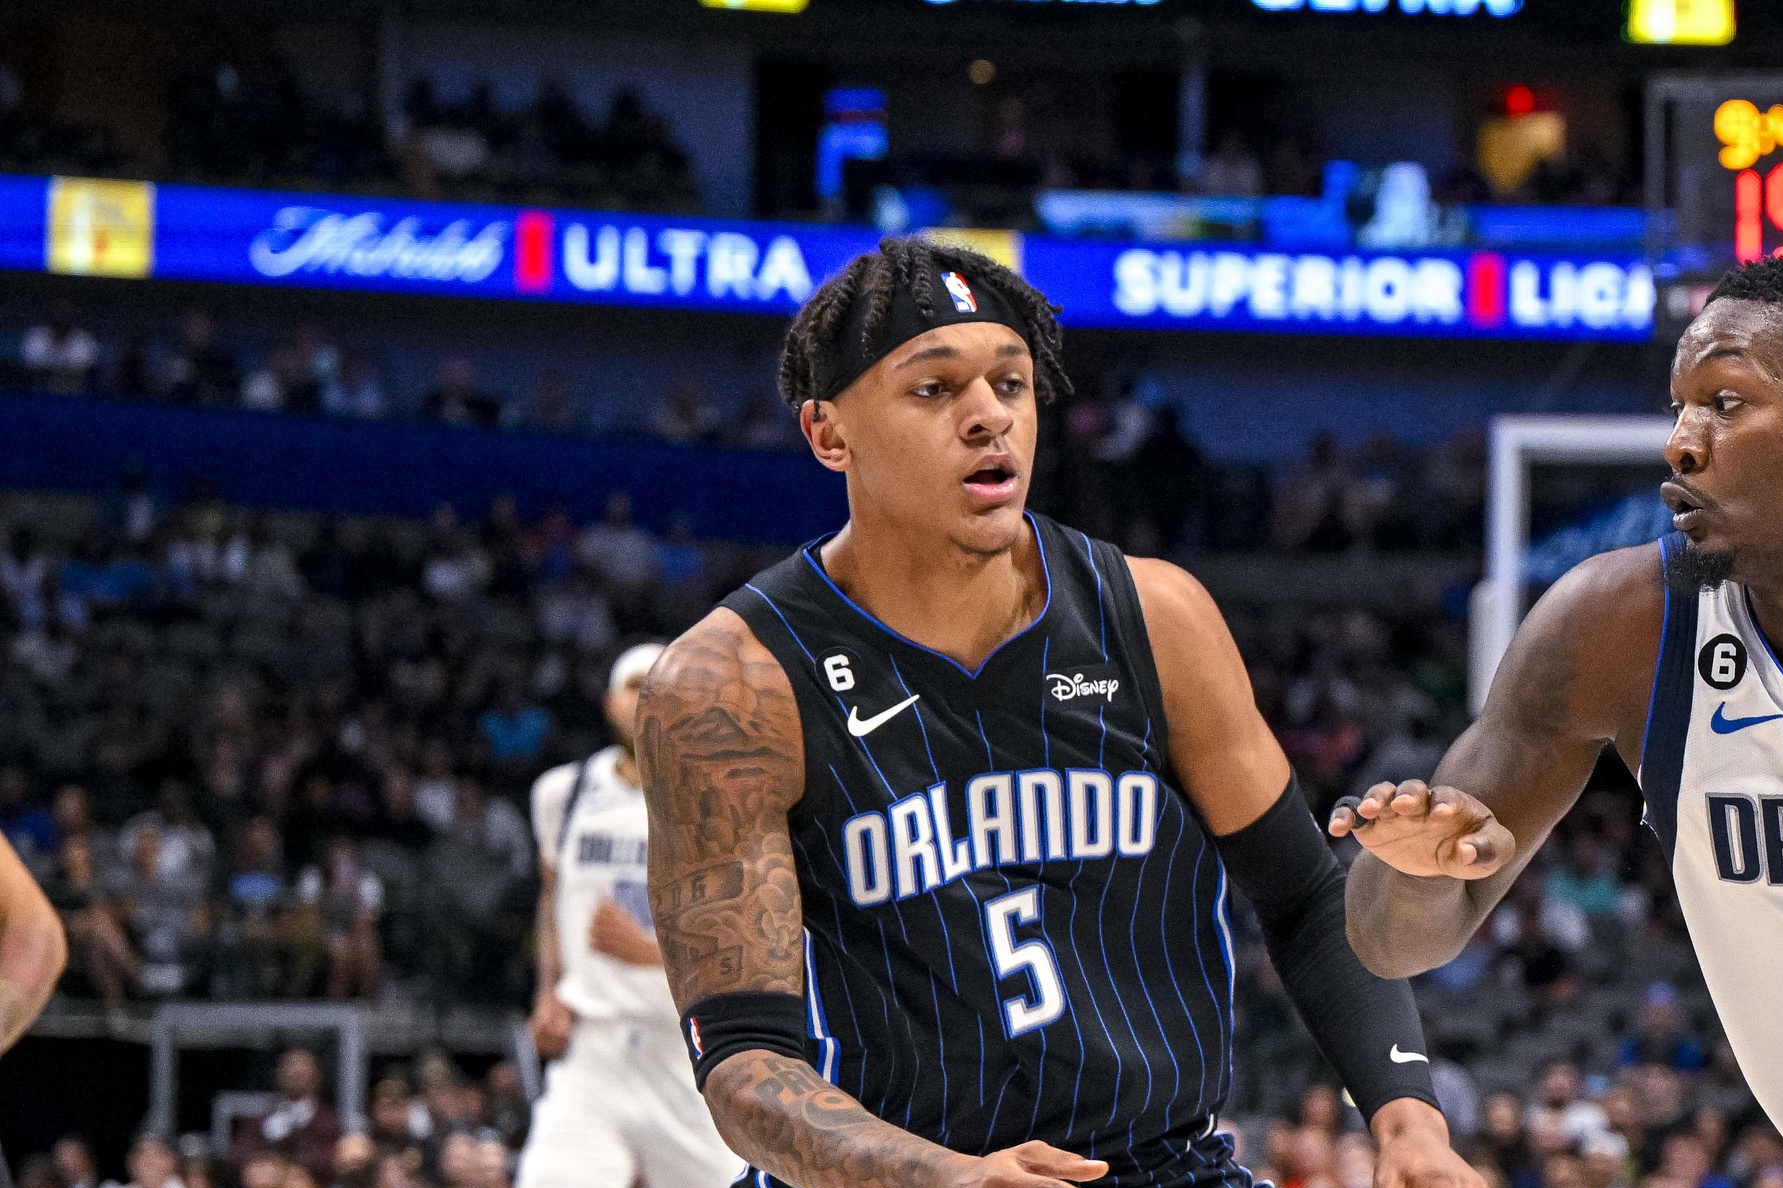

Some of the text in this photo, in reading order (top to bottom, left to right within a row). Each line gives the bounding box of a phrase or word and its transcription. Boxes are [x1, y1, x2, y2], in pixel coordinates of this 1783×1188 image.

[563, 221, 813, 304] ULTRA
[1113, 248, 1464, 326] SUPERIOR
[823, 653, 856, 693] 6
[1710, 642, 1737, 684] 6
[841, 766, 1159, 909] ORLANDO
[984, 883, 1067, 1040] 5
